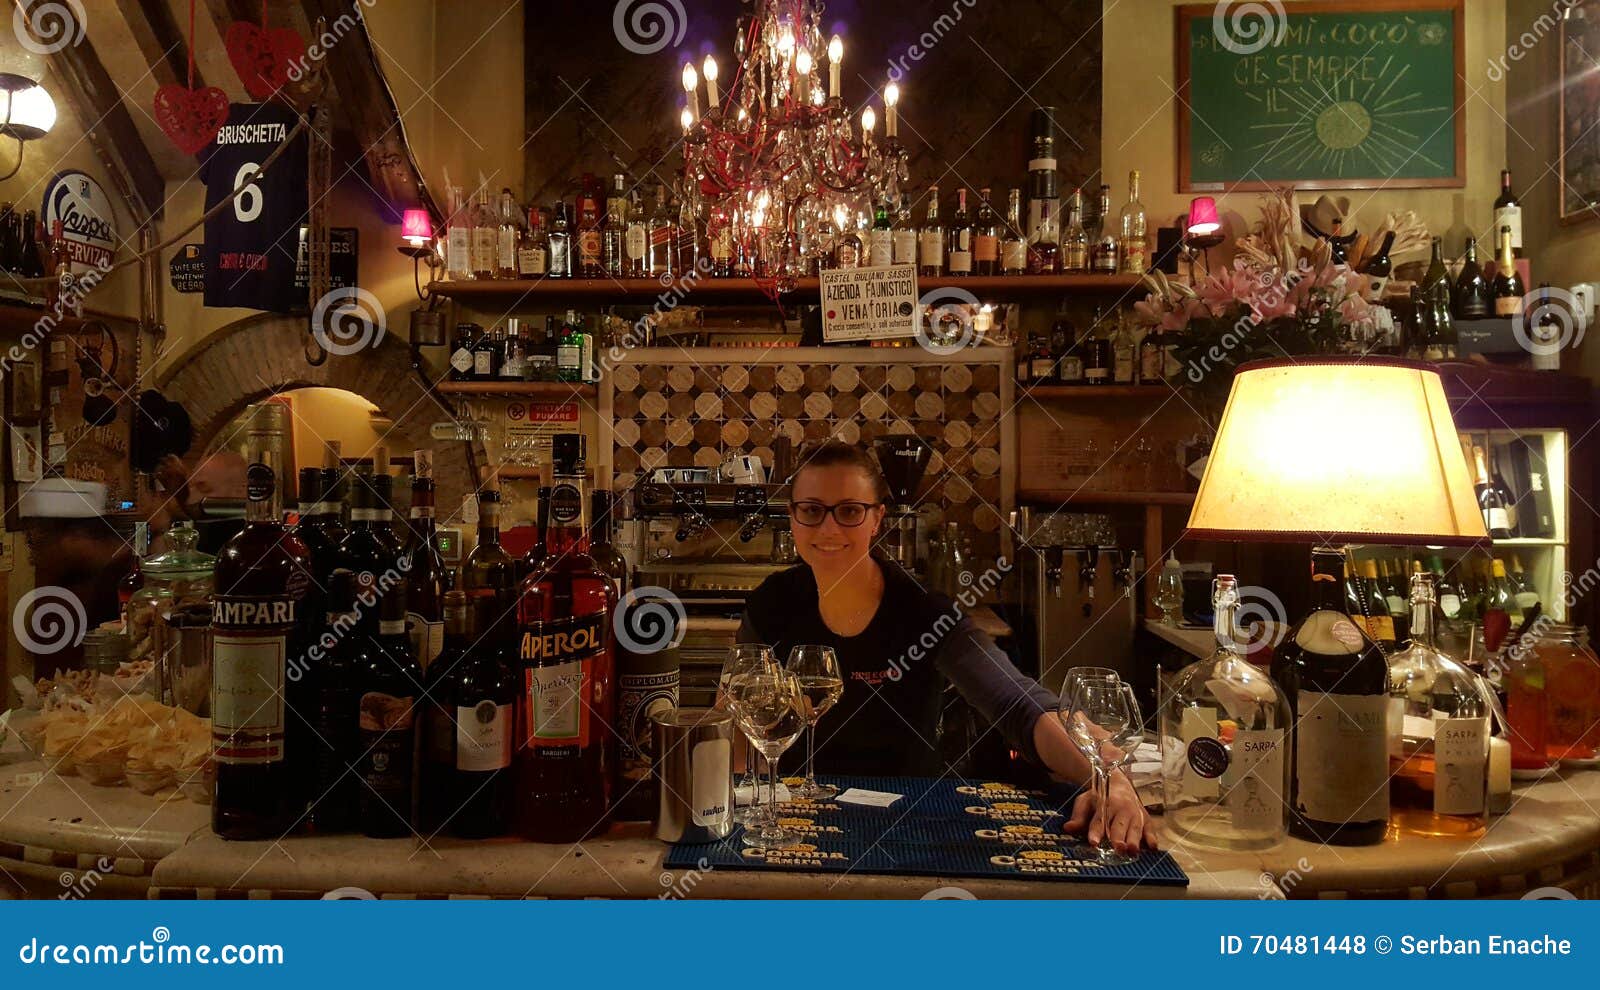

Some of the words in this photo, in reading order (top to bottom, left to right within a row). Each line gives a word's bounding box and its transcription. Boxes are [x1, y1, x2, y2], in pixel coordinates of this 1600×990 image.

[217, 123, 287, 144] BRUSCHETTA
[233, 162, 264, 222] 6
[54, 183, 113, 241] Vespa
[63, 240, 111, 268] ERVIZIO
[825, 274, 850, 284] CASTEL
[887, 269, 912, 279] SASSO
[827, 283, 861, 300] AZIENDA
[865, 280, 913, 298] FAUNISTICO
[535, 412, 571, 420] FUMARE
[521, 625, 600, 660] APEROL
[1446, 730, 1477, 740] SARPA
[1245, 741, 1277, 753] SARPA
[741, 847, 849, 861] Corona
[989, 854, 1103, 868] Corona
